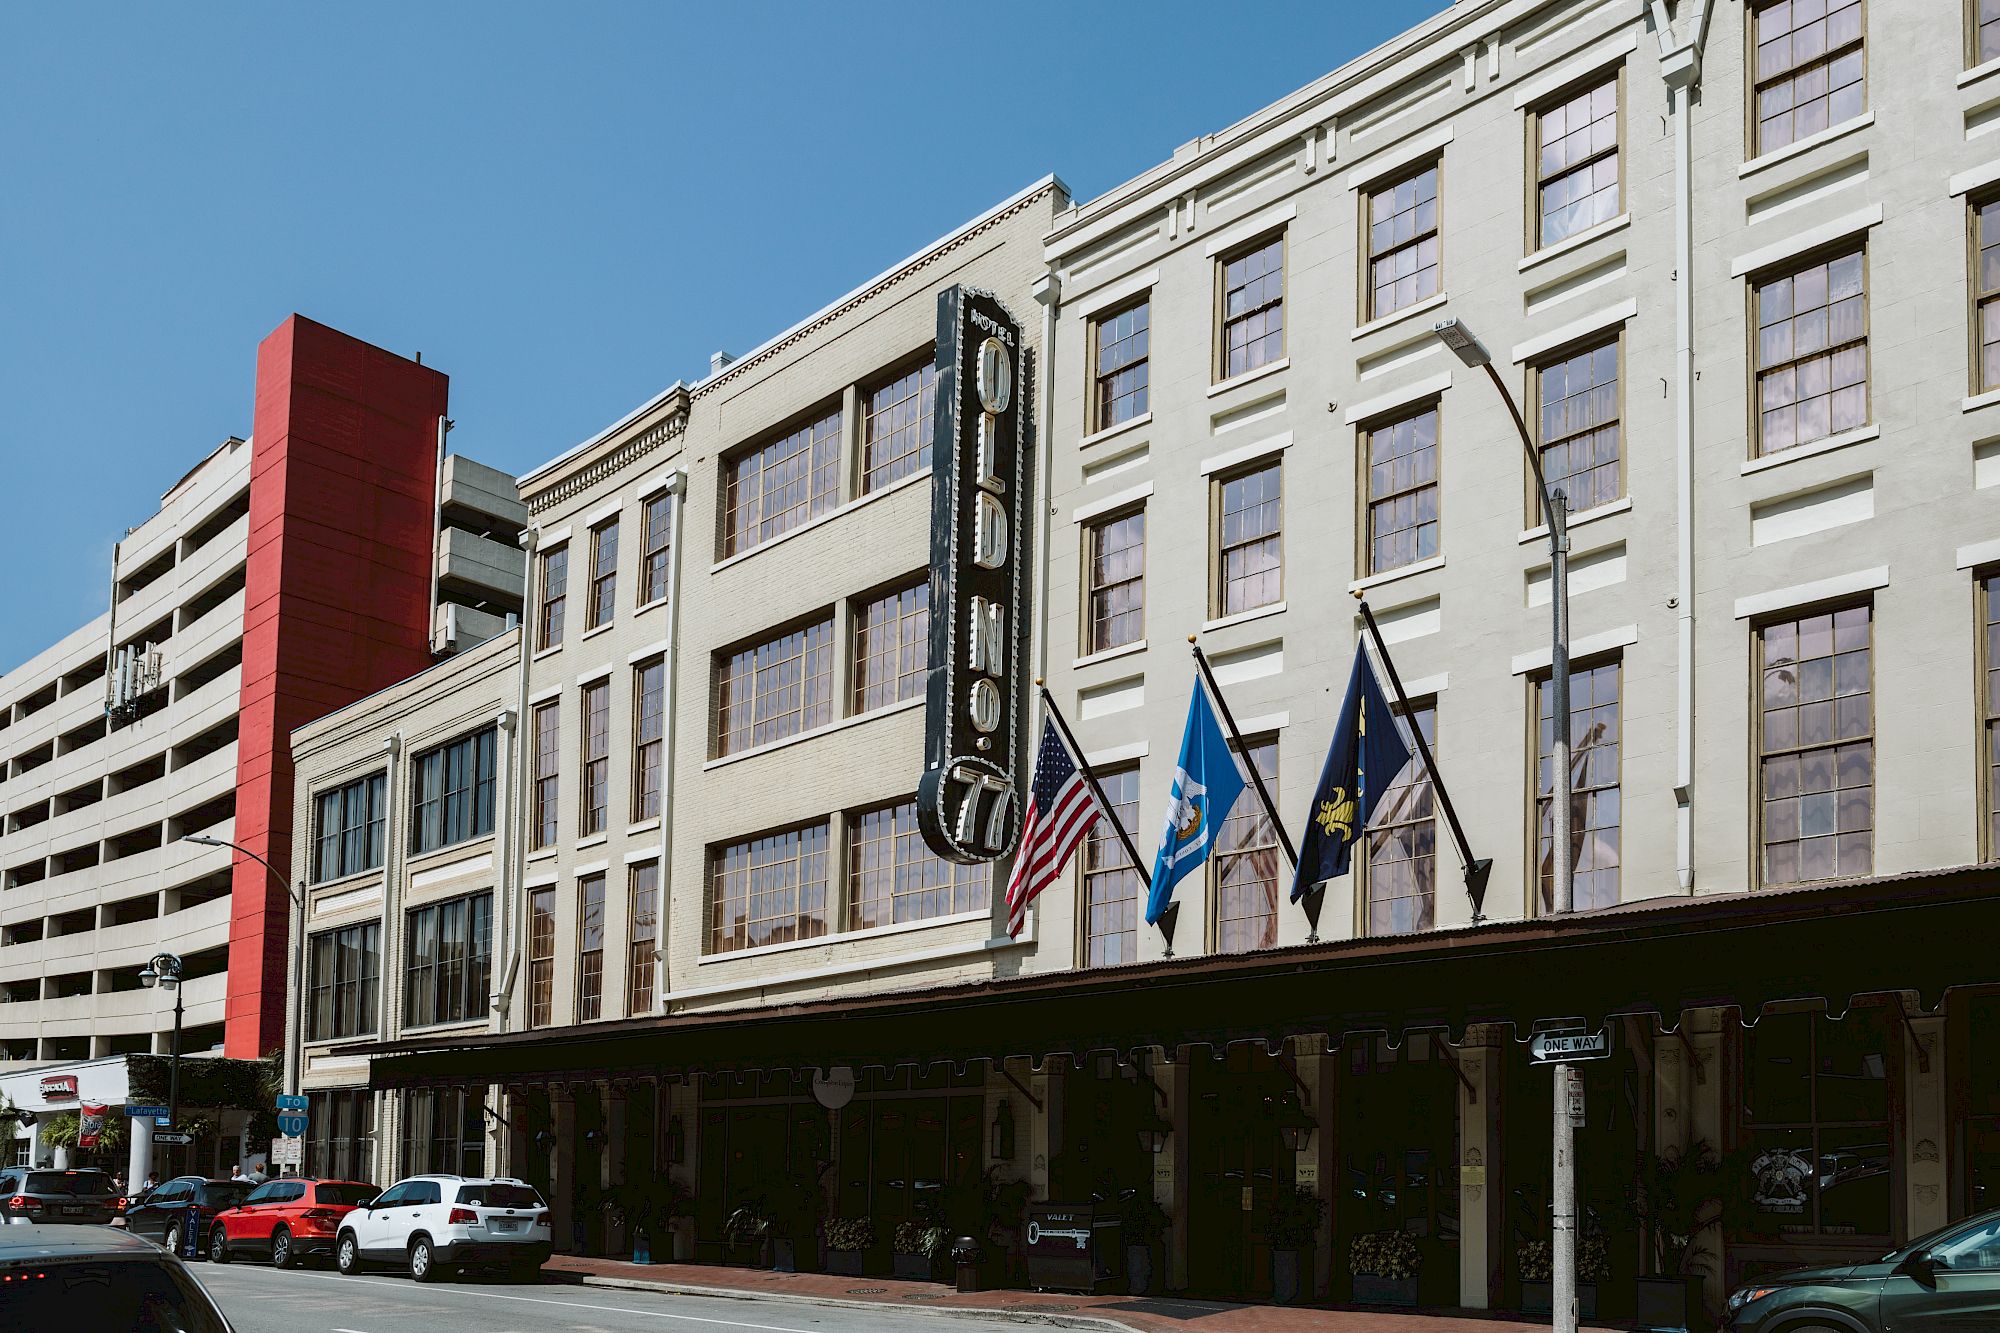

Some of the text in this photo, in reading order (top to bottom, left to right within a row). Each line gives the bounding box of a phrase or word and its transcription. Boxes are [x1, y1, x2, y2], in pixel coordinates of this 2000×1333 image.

[970, 307, 1015, 347] HOTEL
[974, 336, 1011, 570] OLD
[953, 766, 1011, 850] 77
[1543, 1036, 1599, 1051] ONE WAY
[285, 1097, 301, 1107] TO
[131, 1106, 168, 1116] Lafayette
[284, 1117, 302, 1132] 10
[1046, 1213, 1075, 1221] VALET
[188, 1210, 197, 1244] VALET
